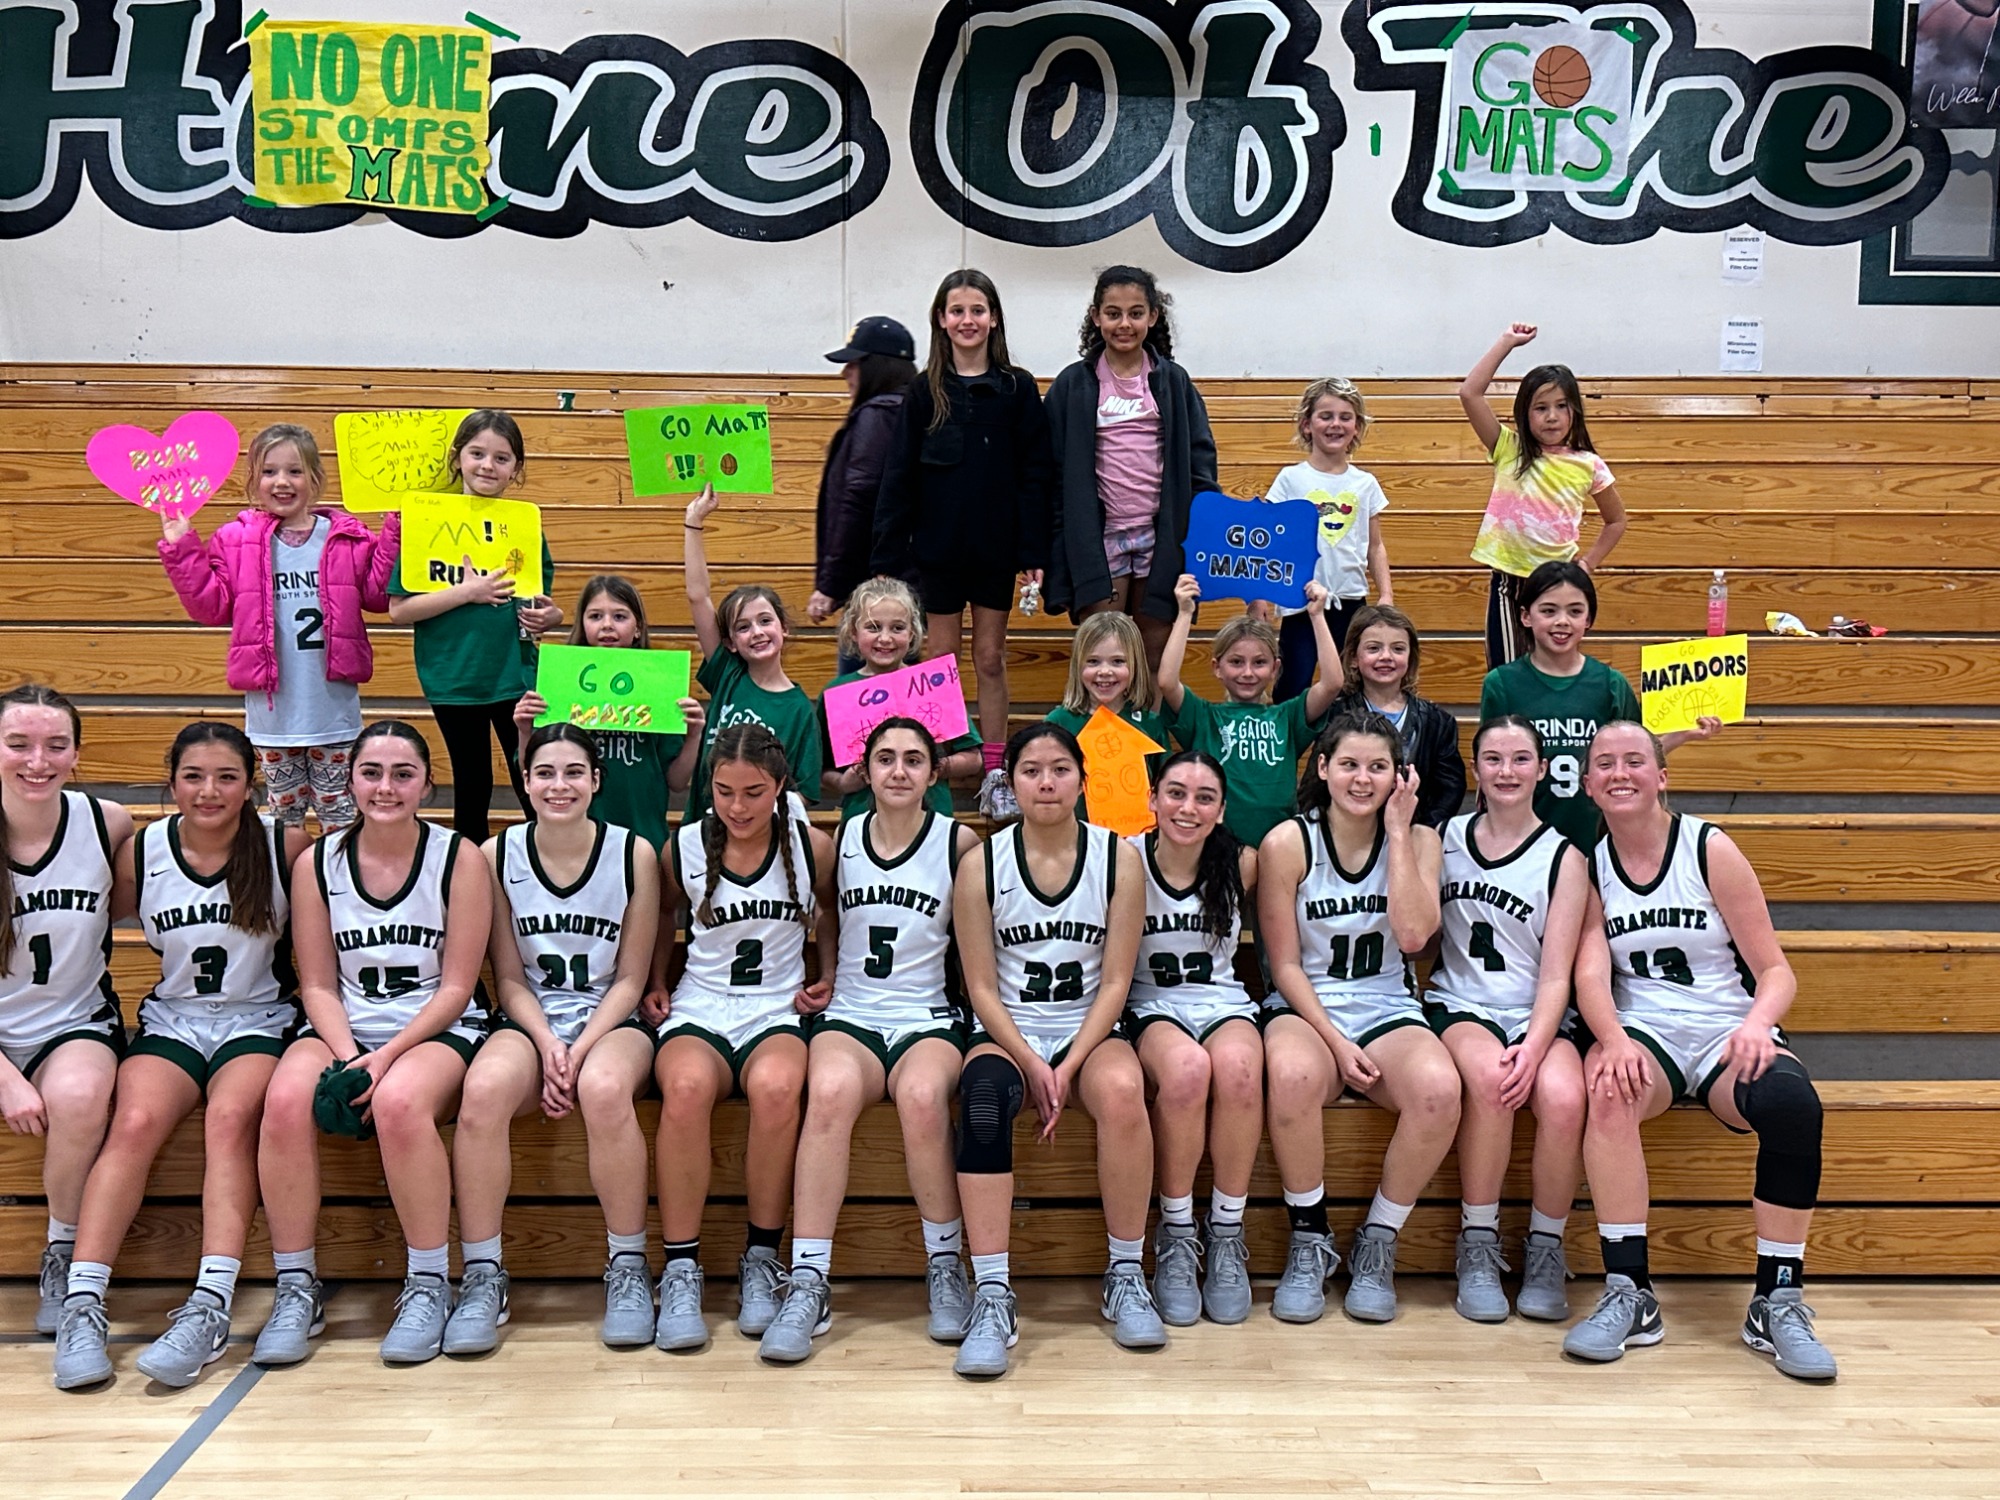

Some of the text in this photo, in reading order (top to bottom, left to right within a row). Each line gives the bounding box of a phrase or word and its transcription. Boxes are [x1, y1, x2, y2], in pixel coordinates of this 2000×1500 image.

[271, 32, 484, 112] NO ONE
[0, 0, 864, 216] Hme
[936, 0, 1320, 247] Of
[258, 108, 476, 155] STOMPS
[1455, 106, 1618, 182] MATS
[262, 145, 483, 211] THE MATS
[1100, 395, 1145, 415] NIKE
[661, 415, 691, 440] GO
[128, 441, 199, 471] RUN
[140, 475, 211, 508] RUN
[1226, 524, 1271, 549] GO
[272, 571, 319, 591] RIND
[1208, 553, 1295, 586] MATS!
[273, 591, 300, 600] OUTH
[295, 608, 325, 651] 2
[1680, 645, 1695, 657] GO
[579, 663, 634, 695] GO
[1642, 655, 1746, 693] MATADORS
[858, 688, 889, 707] GO
[570, 703, 651, 727] MATS
[1239, 715, 1284, 745] GATOR
[1529, 717, 1597, 738] RINDA
[595, 737, 642, 766] GIRL
[1239, 740, 1285, 766] GIRL
[1561, 739, 1591, 747] SPORT
[1088, 762, 1146, 803] GO
[1550, 755, 1579, 798] 9
[12, 888, 100, 919] AMONTE
[706, 899, 803, 930] RAMONTE
[840, 885, 941, 918] MIRAMONTE
[1305, 894, 1388, 921] MIRAMON
[150, 902, 232, 935] MIRAMO
[998, 920, 1108, 947] MIRAMONTE
[29, 933, 52, 985] 1
[863, 925, 898, 979] 5
[1327, 930, 1384, 979] 10
[1469, 921, 1506, 971] 4
[191, 945, 228, 994] 3
[730, 939, 763, 986] 2
[1629, 946, 1695, 985] 13
[358, 966, 422, 998] 15
